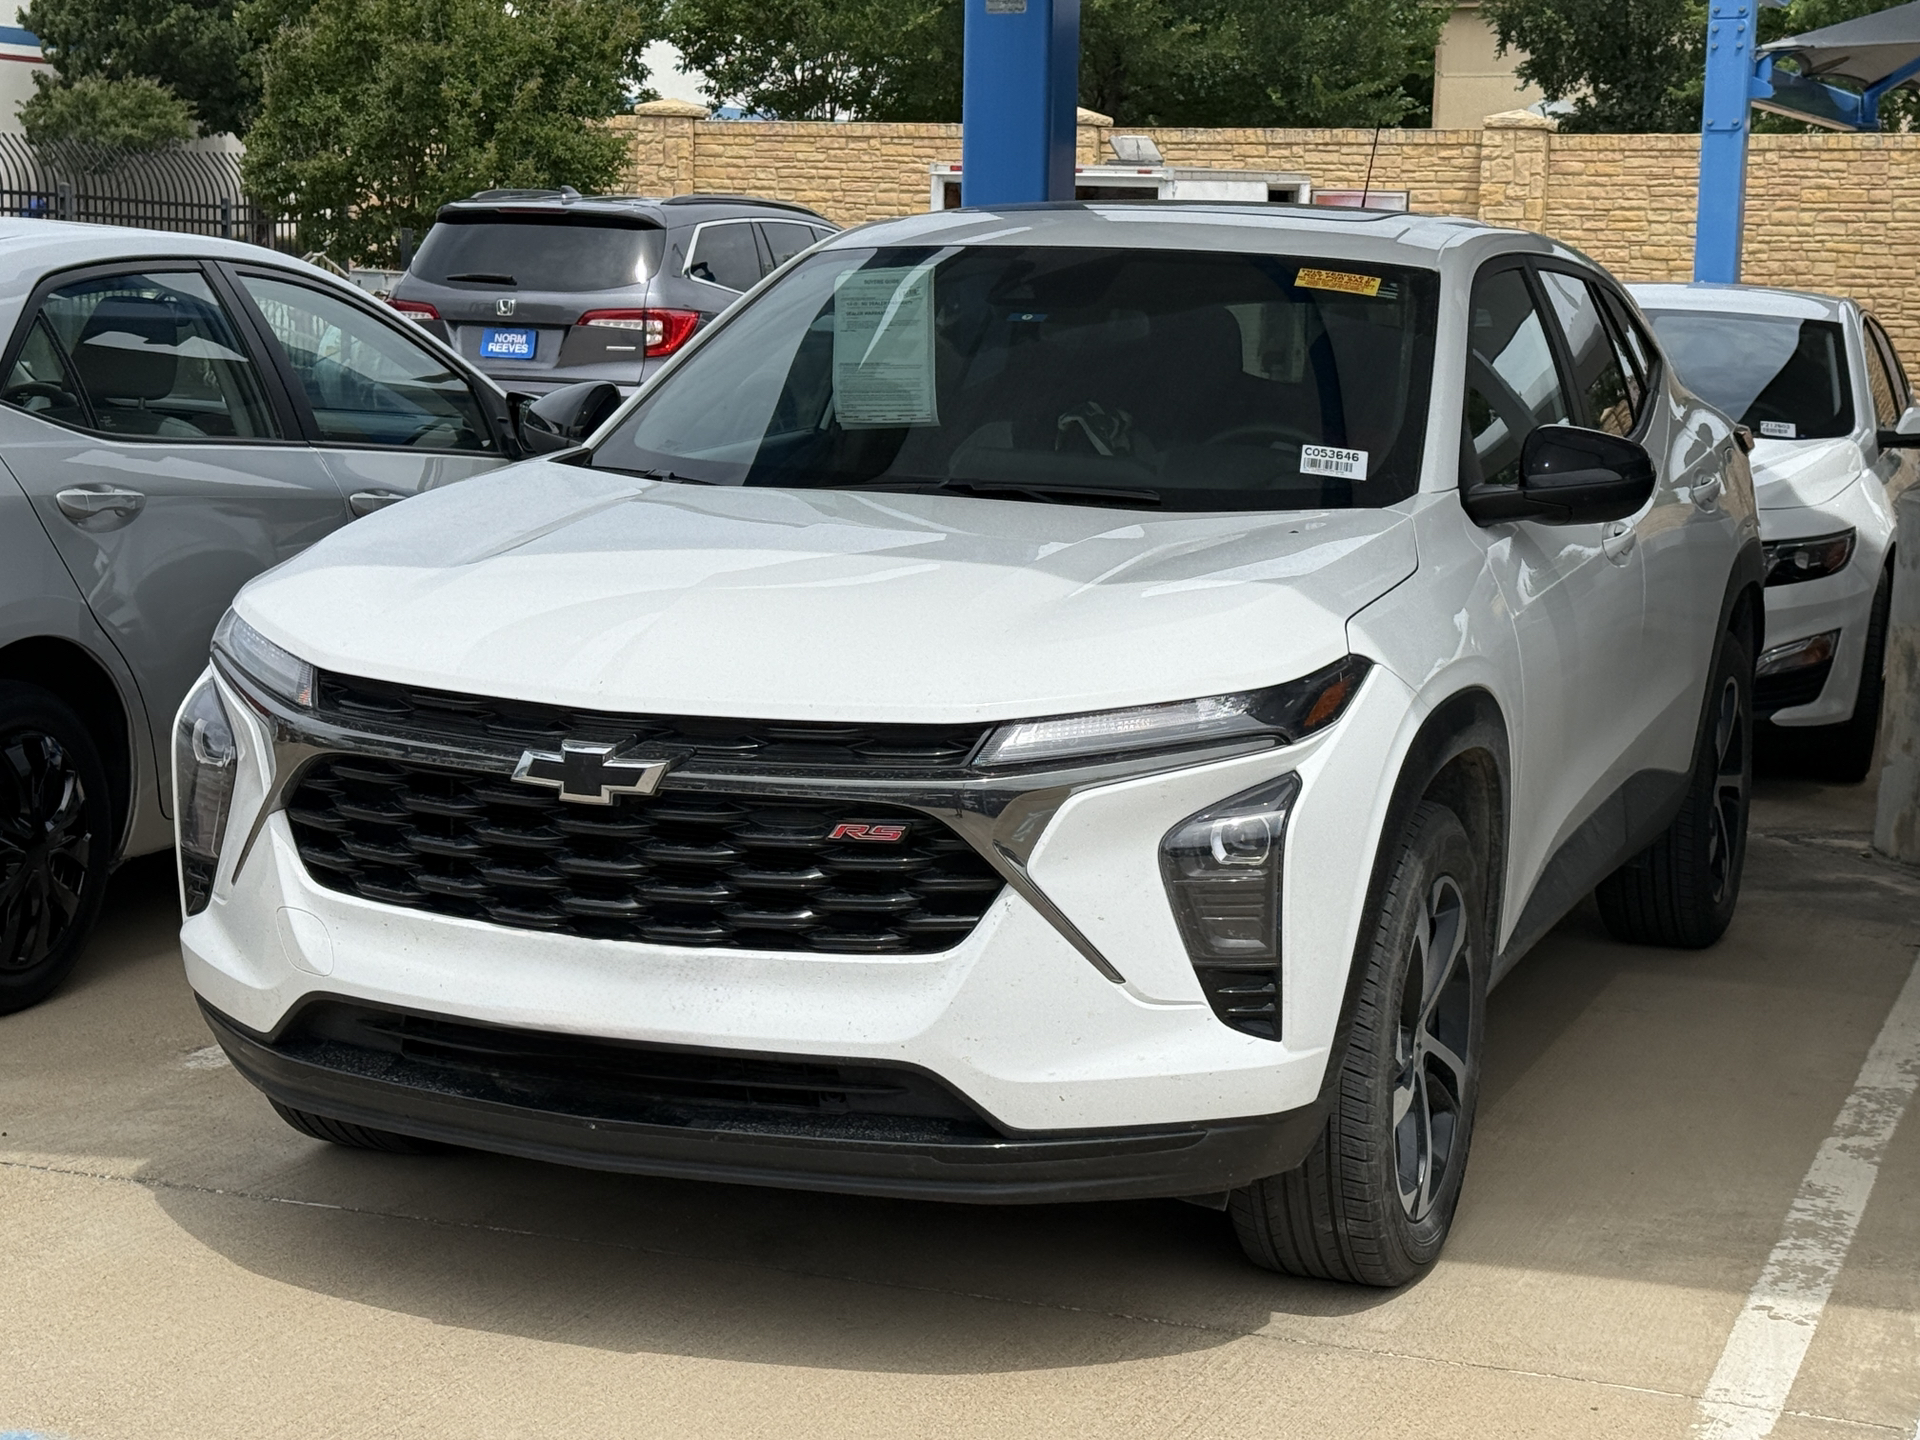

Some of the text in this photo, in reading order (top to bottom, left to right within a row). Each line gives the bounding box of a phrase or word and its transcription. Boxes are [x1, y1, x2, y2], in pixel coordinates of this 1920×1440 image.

[494, 333, 527, 343] NORM
[488, 342, 529, 353] REEVES
[1304, 447, 1360, 462] C053646
[827, 823, 906, 841] RS
